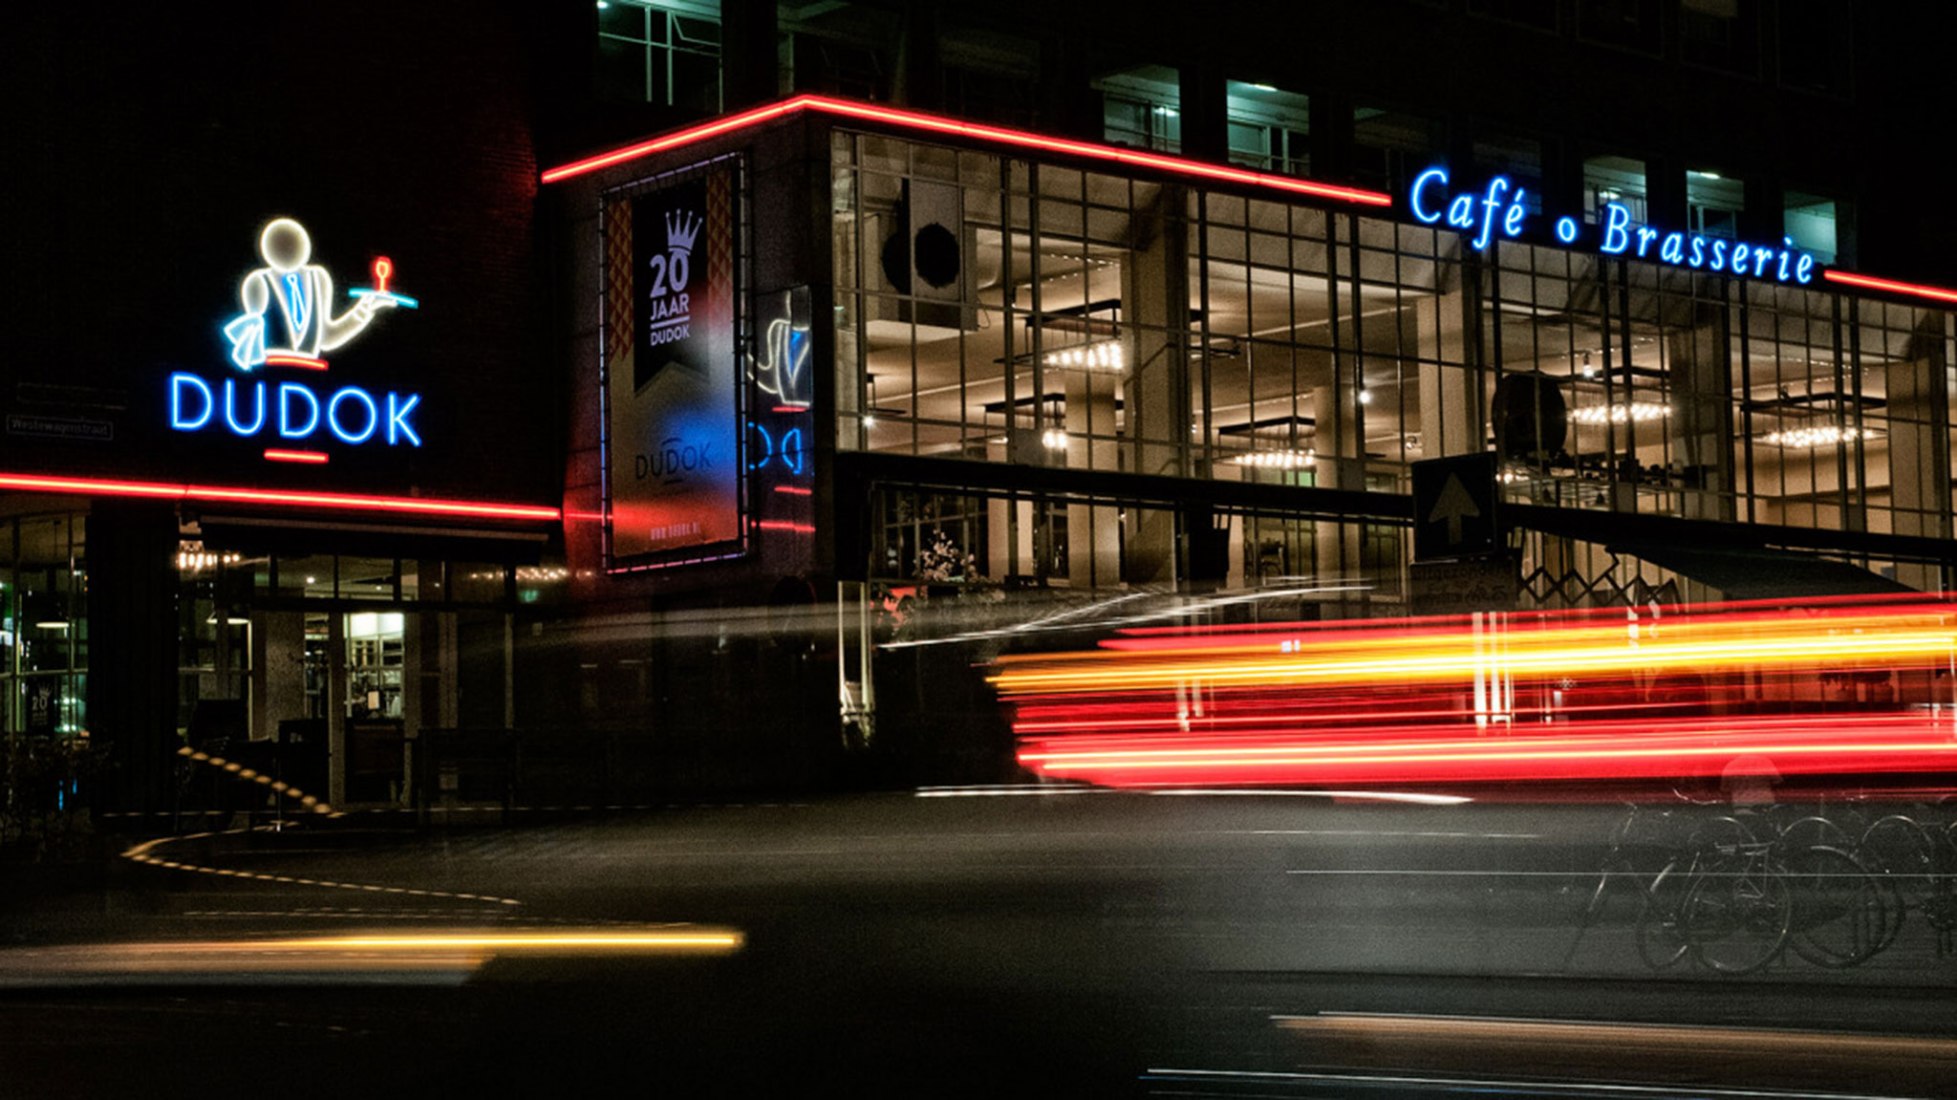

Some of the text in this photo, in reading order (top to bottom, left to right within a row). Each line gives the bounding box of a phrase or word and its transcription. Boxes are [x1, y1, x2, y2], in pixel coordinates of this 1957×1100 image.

[1410, 166, 1526, 251] Café
[1600, 203, 1814, 285] Brasserie
[649, 251, 691, 298] 20
[650, 293, 690, 322] JAAR
[650, 324, 691, 347] DUDOK
[171, 371, 421, 447] DUDOK
[635, 441, 713, 480] DUDOK
[31, 695, 48, 711] 20
